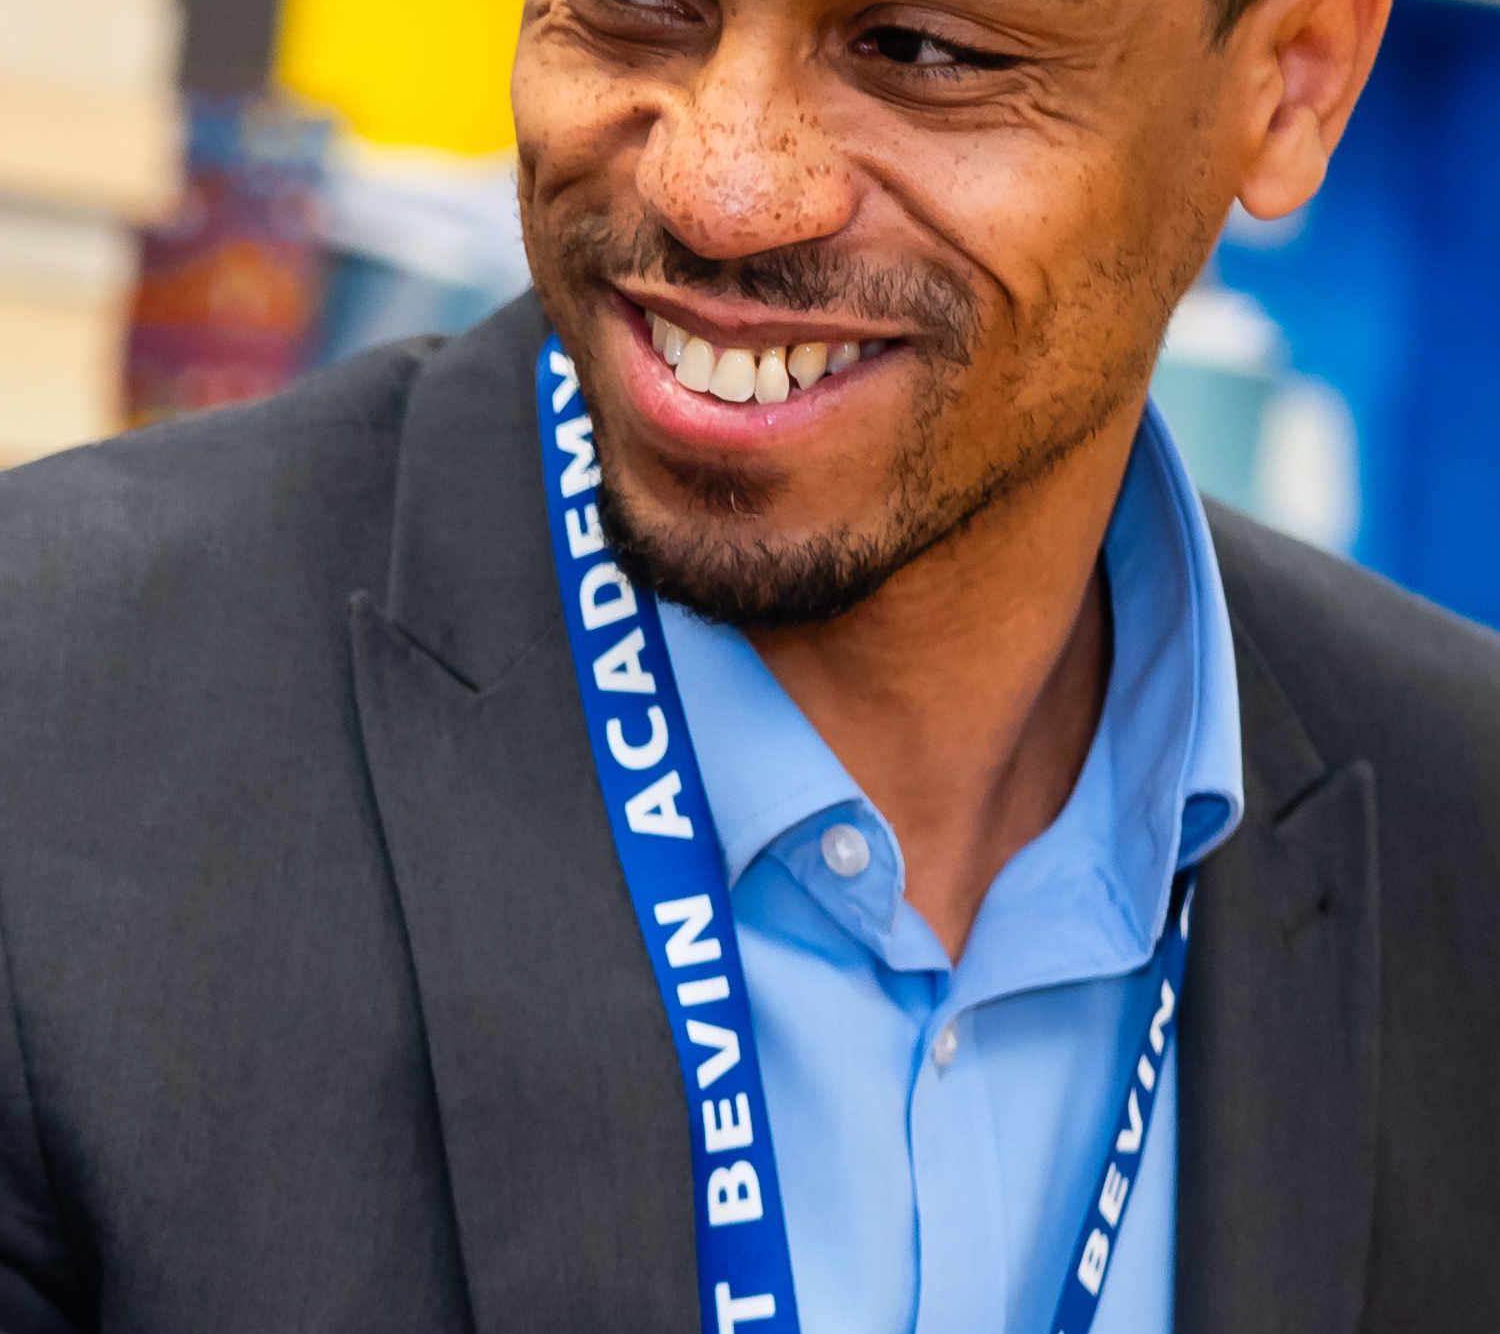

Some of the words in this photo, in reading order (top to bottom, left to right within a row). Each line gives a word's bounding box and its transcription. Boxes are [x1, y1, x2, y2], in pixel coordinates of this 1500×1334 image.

[549, 350, 695, 839] ACADEMY
[654, 894, 764, 1225] BEVIN
[1077, 978, 1176, 1296] BEVIN
